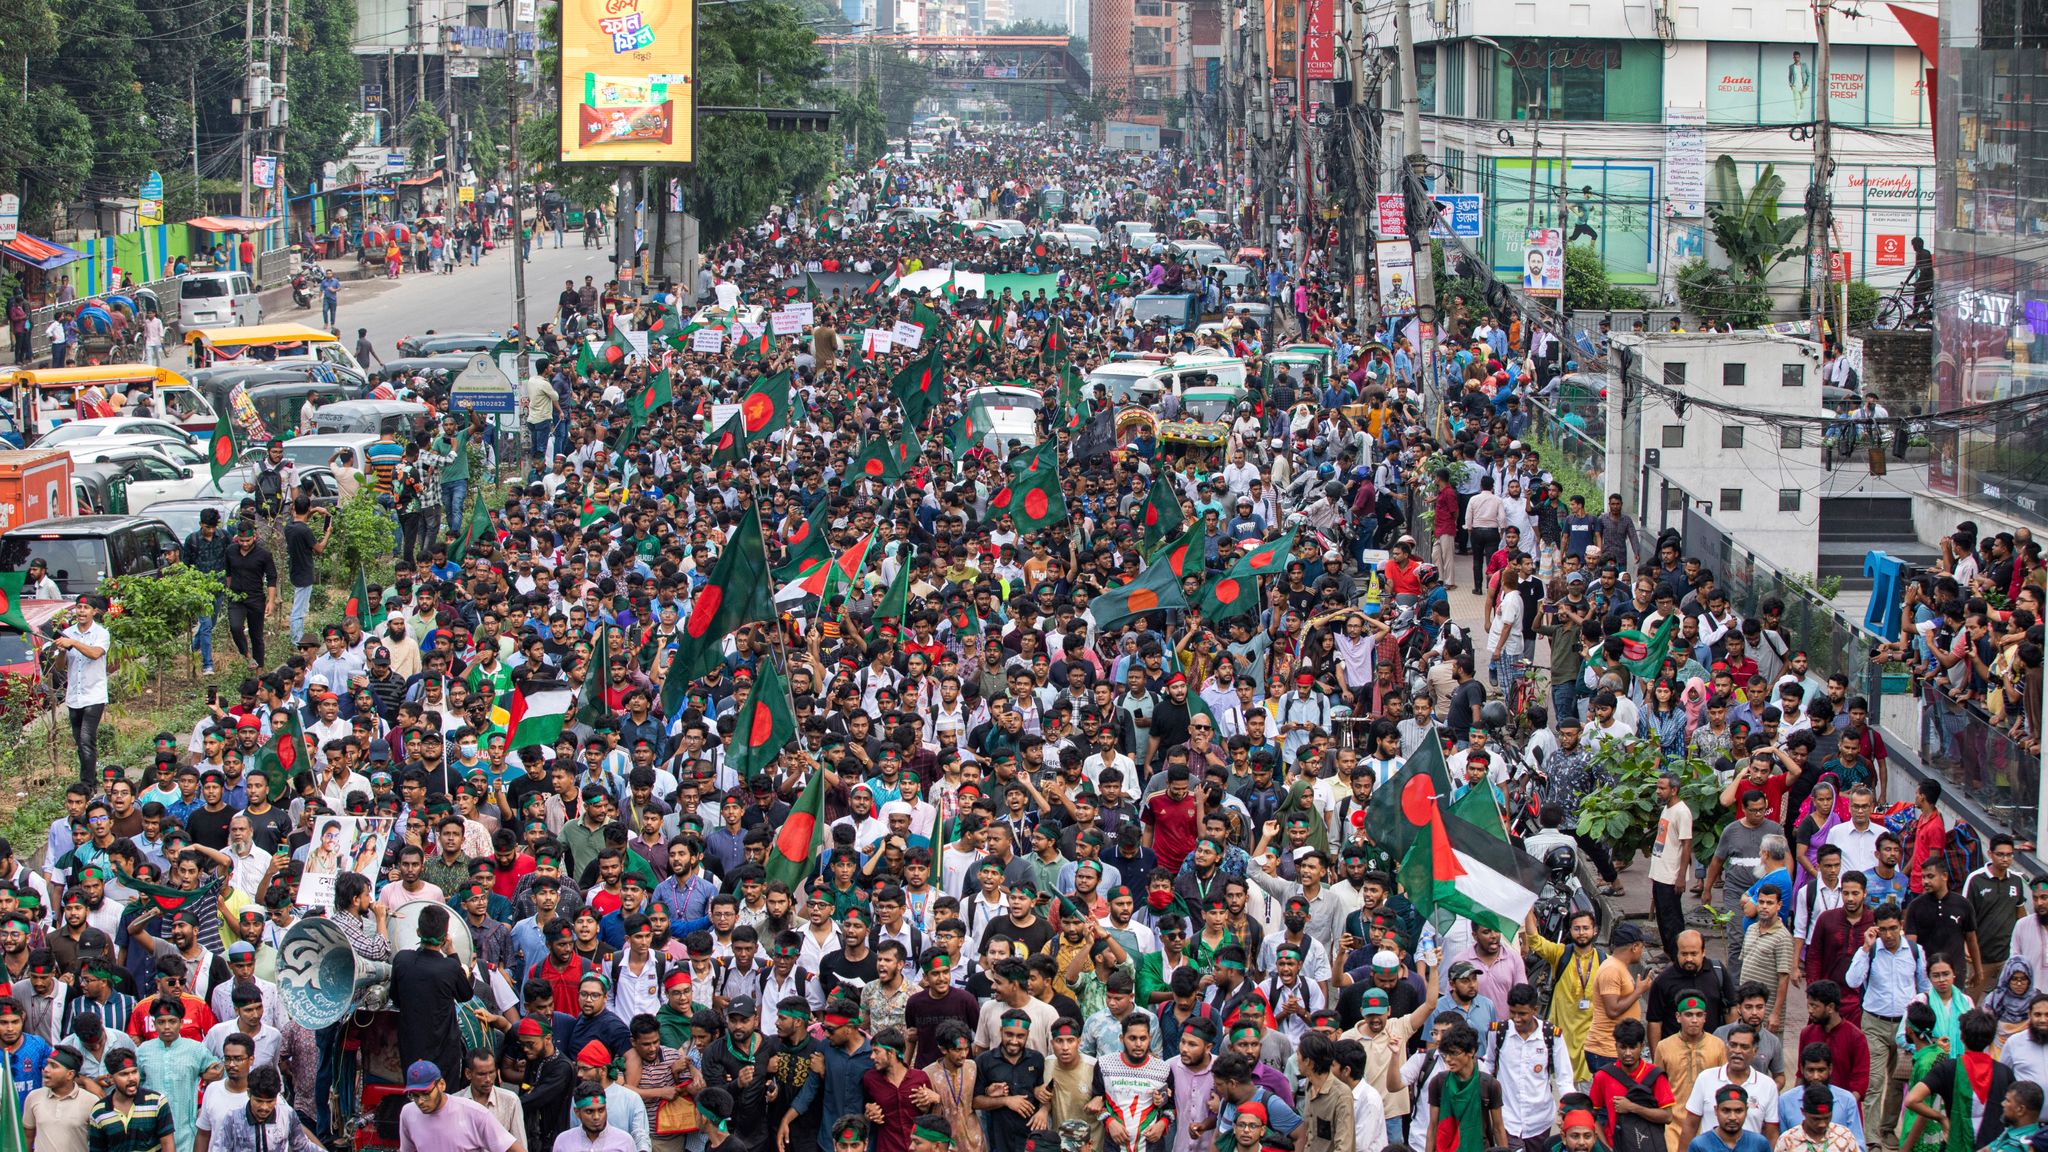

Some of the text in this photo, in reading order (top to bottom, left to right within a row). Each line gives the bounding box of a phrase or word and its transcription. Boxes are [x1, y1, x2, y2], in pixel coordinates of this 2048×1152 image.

[600, 13, 640, 33] ফান
[614, 25, 654, 52] ফিল
[1502, 40, 1621, 69] Bata
[1721, 75, 1752, 84] Bata
[1830, 73, 1864, 82] TRENDY
[1733, 85, 1756, 93] LABEL
[1830, 82, 1864, 91] STYLISH
[1830, 91, 1858, 99] FRESH
[1848, 174, 1911, 194] Surprisingly
[1868, 187, 1936, 201] Rewarding
[1506, 242, 1518, 252] TO
[1957, 286, 2010, 327] SONY
[2017, 496, 2036, 511] SONY
